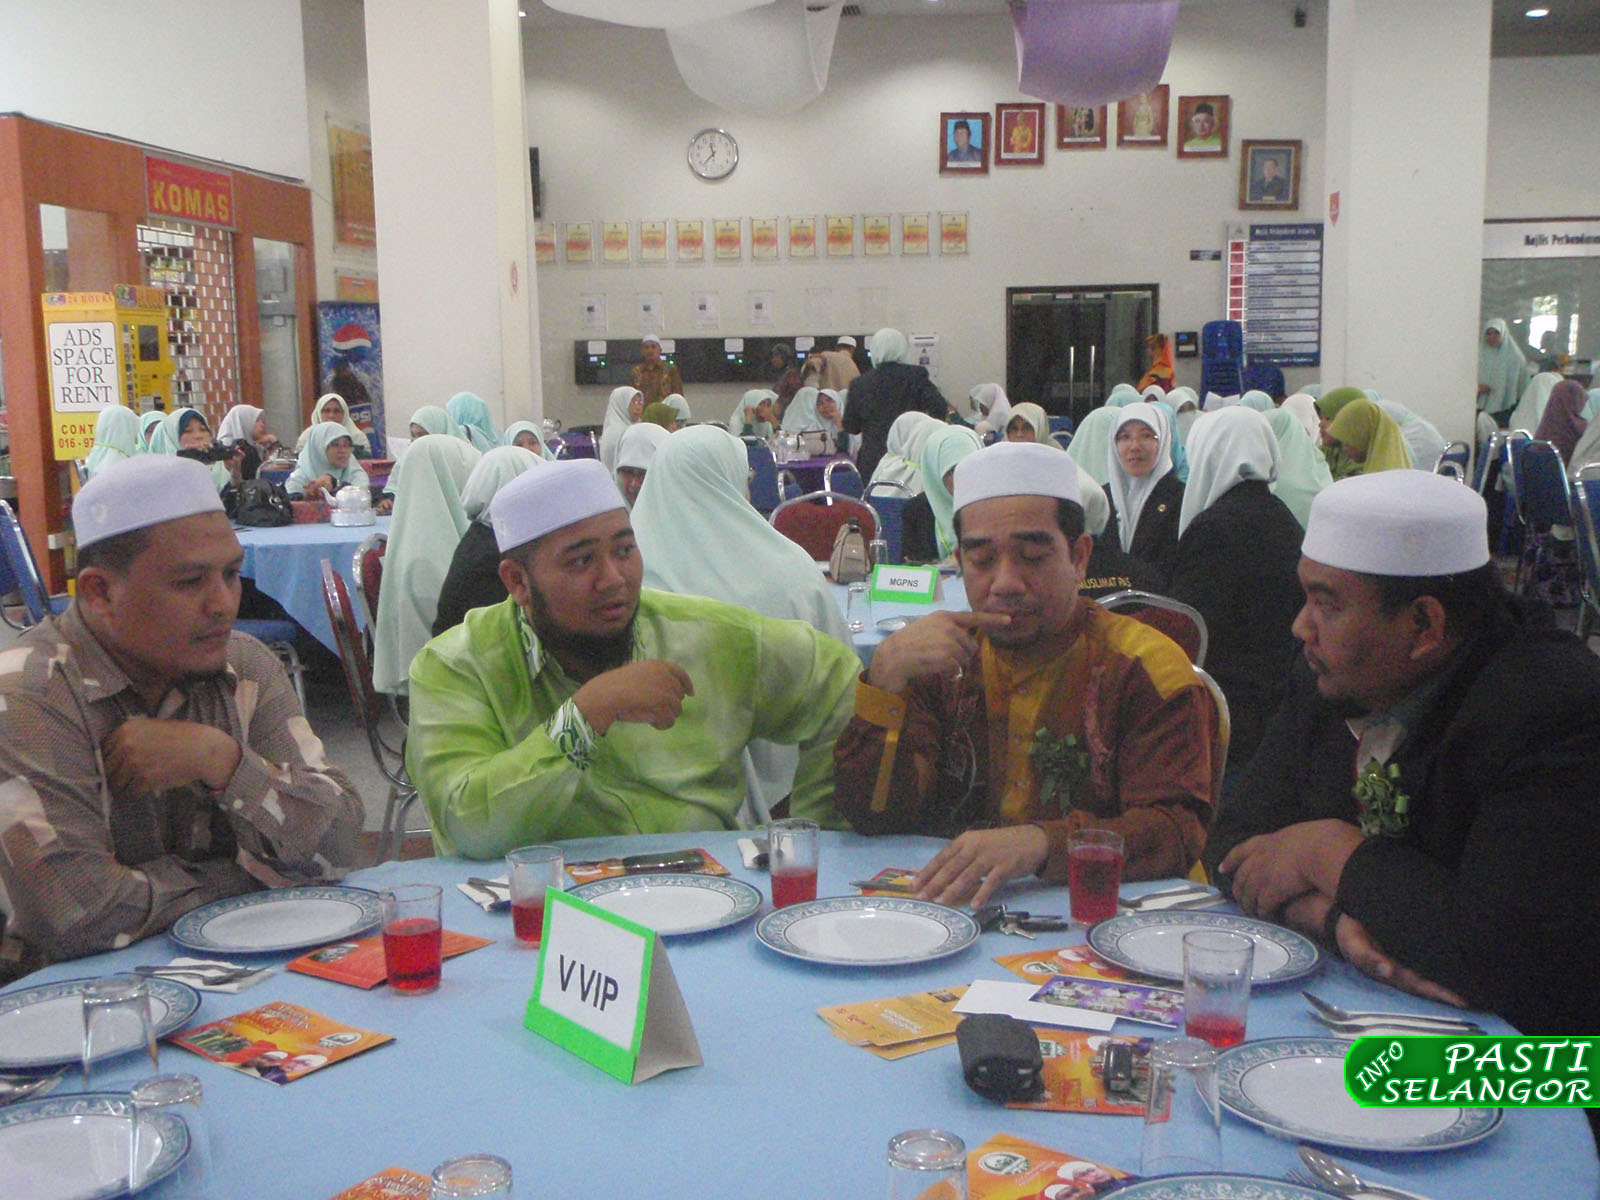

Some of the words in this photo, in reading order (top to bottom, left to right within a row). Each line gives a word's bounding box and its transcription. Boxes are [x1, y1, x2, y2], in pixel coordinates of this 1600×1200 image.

[153, 180, 229, 221] KOMAS
[64, 328, 102, 346] ADS
[53, 347, 115, 366] SPACE
[66, 366, 105, 384] FOR
[61, 386, 112, 403] RENT
[61, 424, 95, 435] CONT
[58, 437, 96, 449] 016-97
[889, 577, 919, 588] MGPNS
